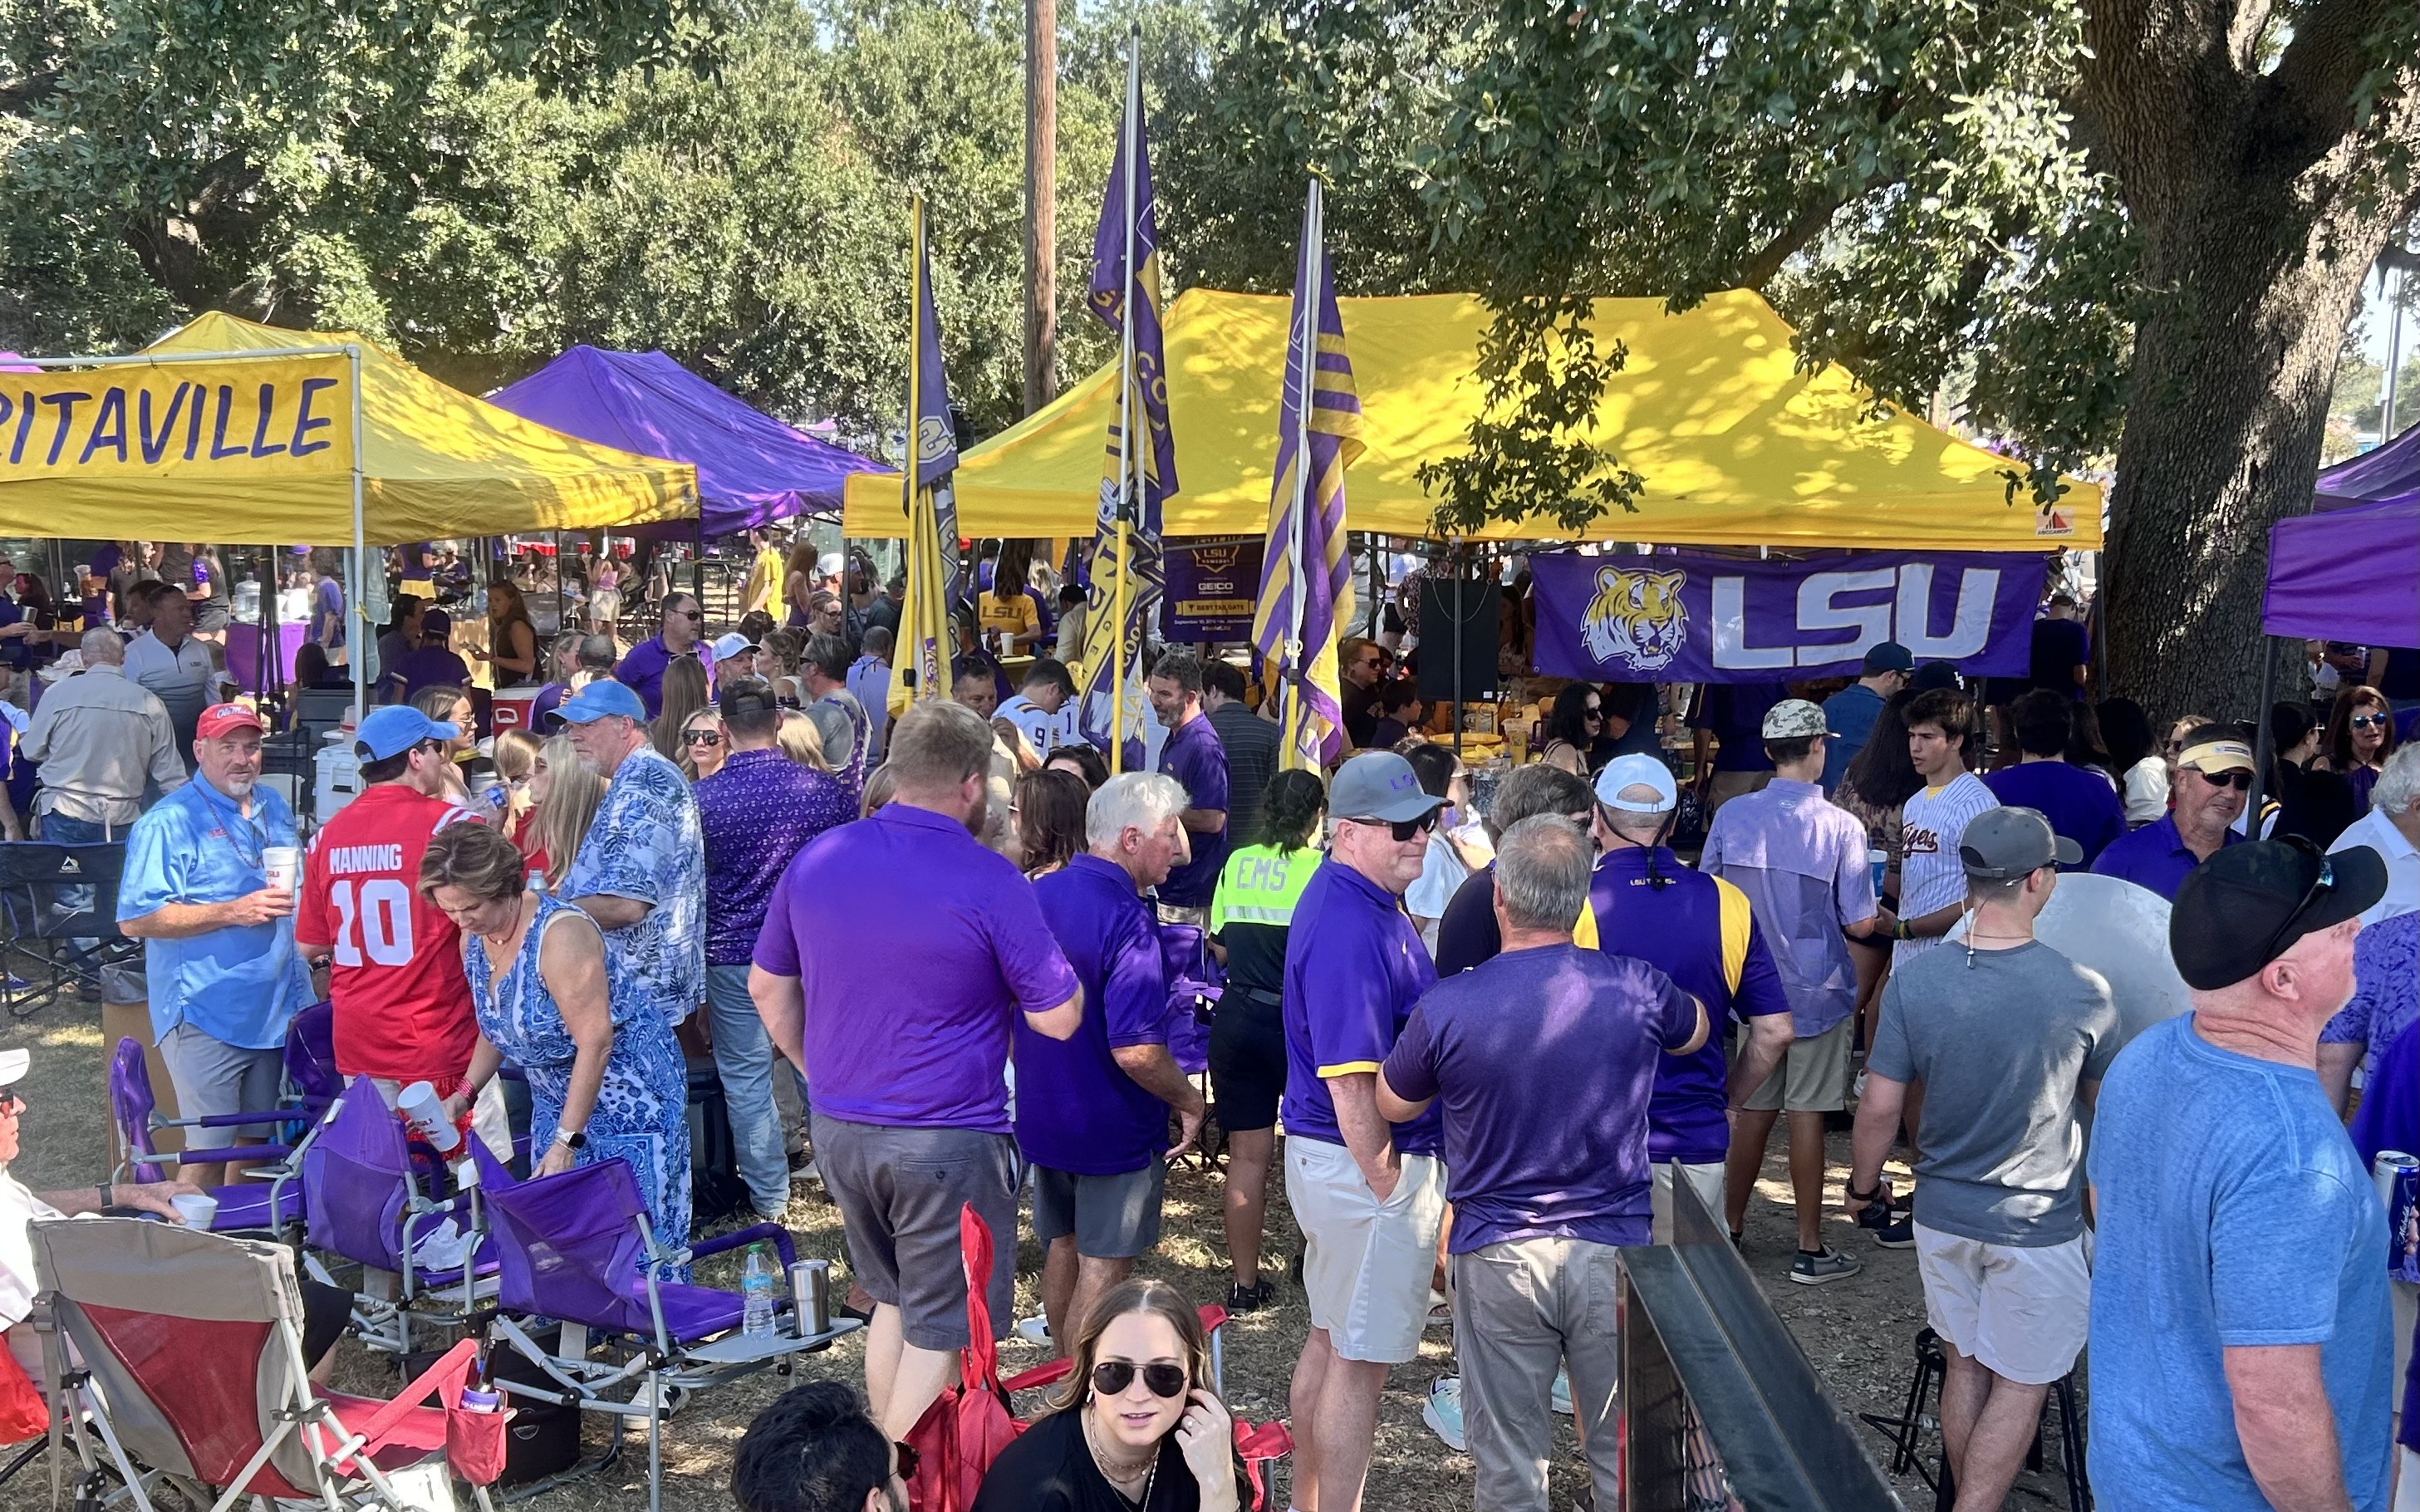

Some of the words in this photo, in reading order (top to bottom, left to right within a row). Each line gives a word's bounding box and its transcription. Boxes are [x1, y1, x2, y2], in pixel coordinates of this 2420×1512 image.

[1203, 548, 1227, 557] LSU
[1198, 582, 1234, 591] GEICO
[982, 606, 1022, 618] LSU
[1711, 562, 2001, 669] LSU
[1034, 727, 1046, 748] 9
[1902, 822, 1938, 857] Tigers
[329, 843, 403, 875] MANNING
[265, 870, 281, 878] SU
[1236, 857, 1289, 891] EMS
[331, 878, 415, 967] 10
